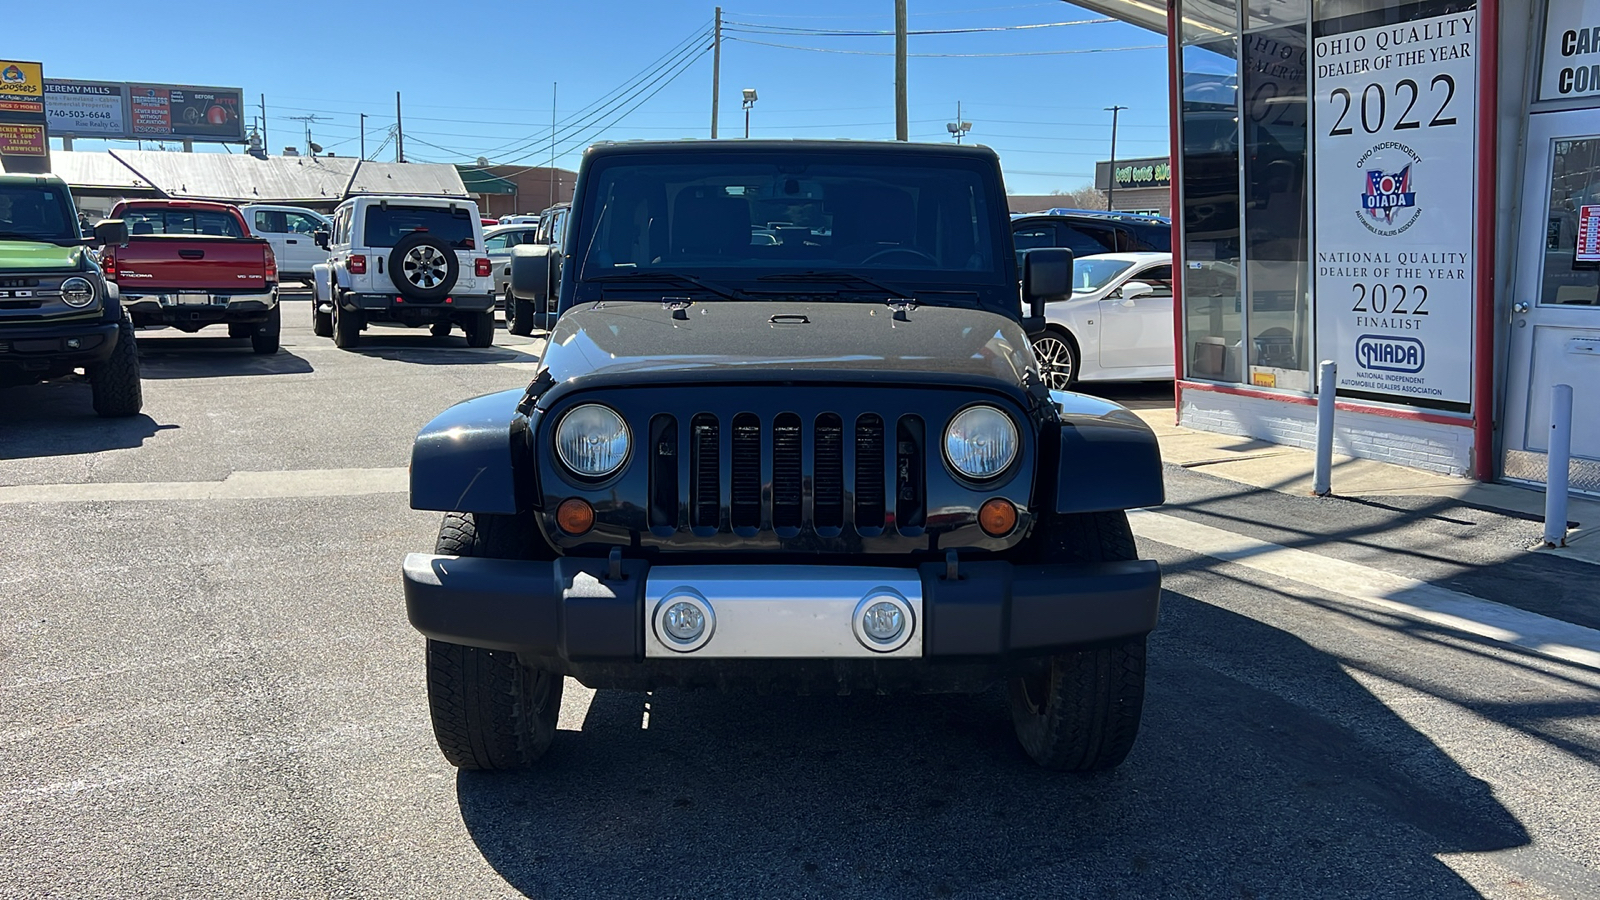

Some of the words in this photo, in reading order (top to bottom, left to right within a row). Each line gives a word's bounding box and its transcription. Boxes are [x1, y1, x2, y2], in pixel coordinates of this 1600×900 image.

[1316, 34, 1366, 58] OHIO
[1376, 16, 1474, 51] QUALITY
[1318, 58, 1370, 79] DEALER
[1373, 55, 1393, 71] OF
[1397, 49, 1426, 67] THE
[1429, 42, 1472, 62] YEAR
[45, 85, 81, 93] JEREMY
[1329, 73, 1458, 137] 2022
[48, 110, 111, 119] 740-503-6648
[3, 145, 42, 153] SANDWICHES
[1355, 150, 1373, 169] OHIO
[1372, 141, 1422, 165] INDEPENDENT
[1367, 194, 1406, 208] OIADA
[1355, 210, 1378, 235] AUTOMOBILE
[1377, 229, 1398, 237] DEALERS
[1397, 207, 1423, 234] ASSOCIATION
[1318, 252, 1391, 264] NATIONAL
[1398, 252, 1468, 265] QUALITY
[1320, 267, 1368, 278] DEALER
[1373, 267, 1390, 278] OF
[1395, 268, 1422, 278] THE
[1428, 269, 1466, 280] YEAR
[1352, 283, 1430, 316] 2022
[1356, 316, 1422, 330] FINALIST
[1361, 341, 1418, 367] NIADA
[1356, 371, 1384, 380] NATIONAL
[1386, 374, 1425, 385] INDEPENDENT
[1341, 379, 1376, 389] AUTOMOBILE
[1377, 382, 1401, 392] DEALERS
[1402, 386, 1443, 396] ASSOCIATION
